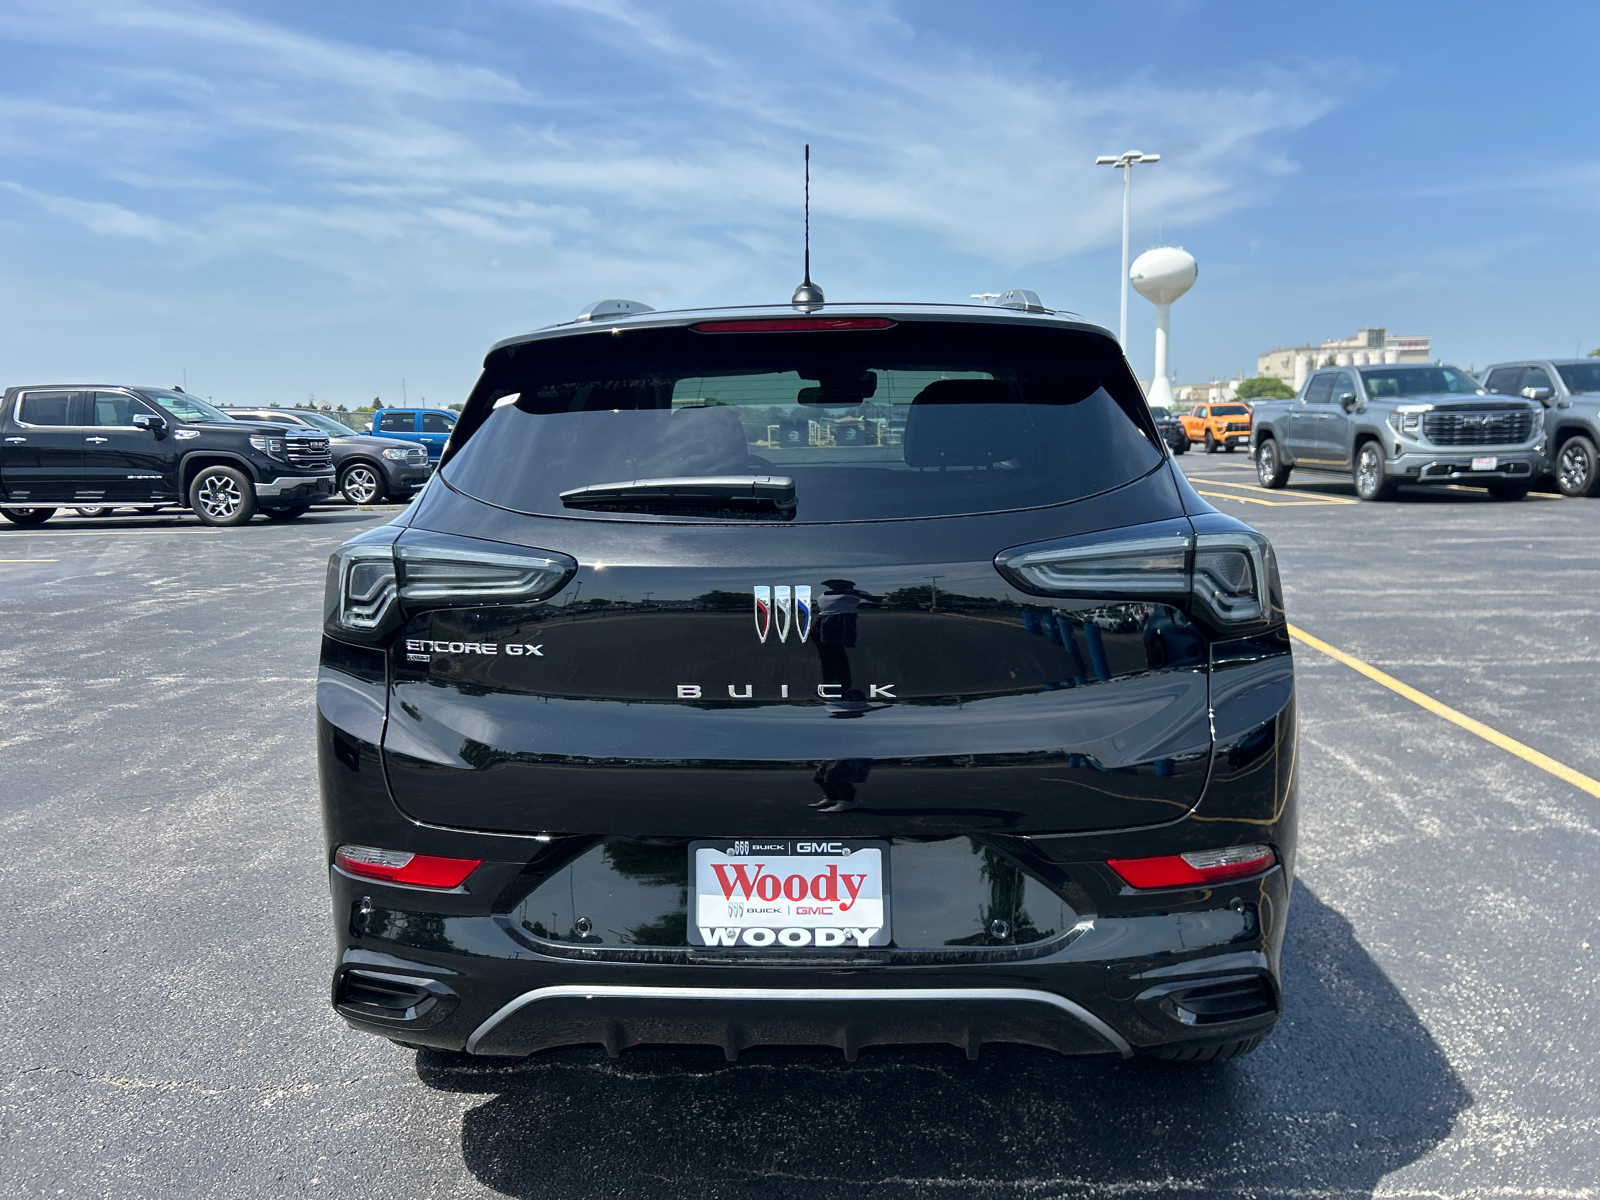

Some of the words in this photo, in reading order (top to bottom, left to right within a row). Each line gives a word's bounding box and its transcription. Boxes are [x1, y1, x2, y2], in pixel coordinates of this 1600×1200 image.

[405, 639, 498, 655] ENCORE
[505, 643, 544, 656] GX
[676, 684, 897, 698] BUICK
[796, 842, 842, 853] GMC
[710, 863, 868, 911] Woody
[796, 906, 833, 915] GMC
[698, 927, 881, 947] WOODY
